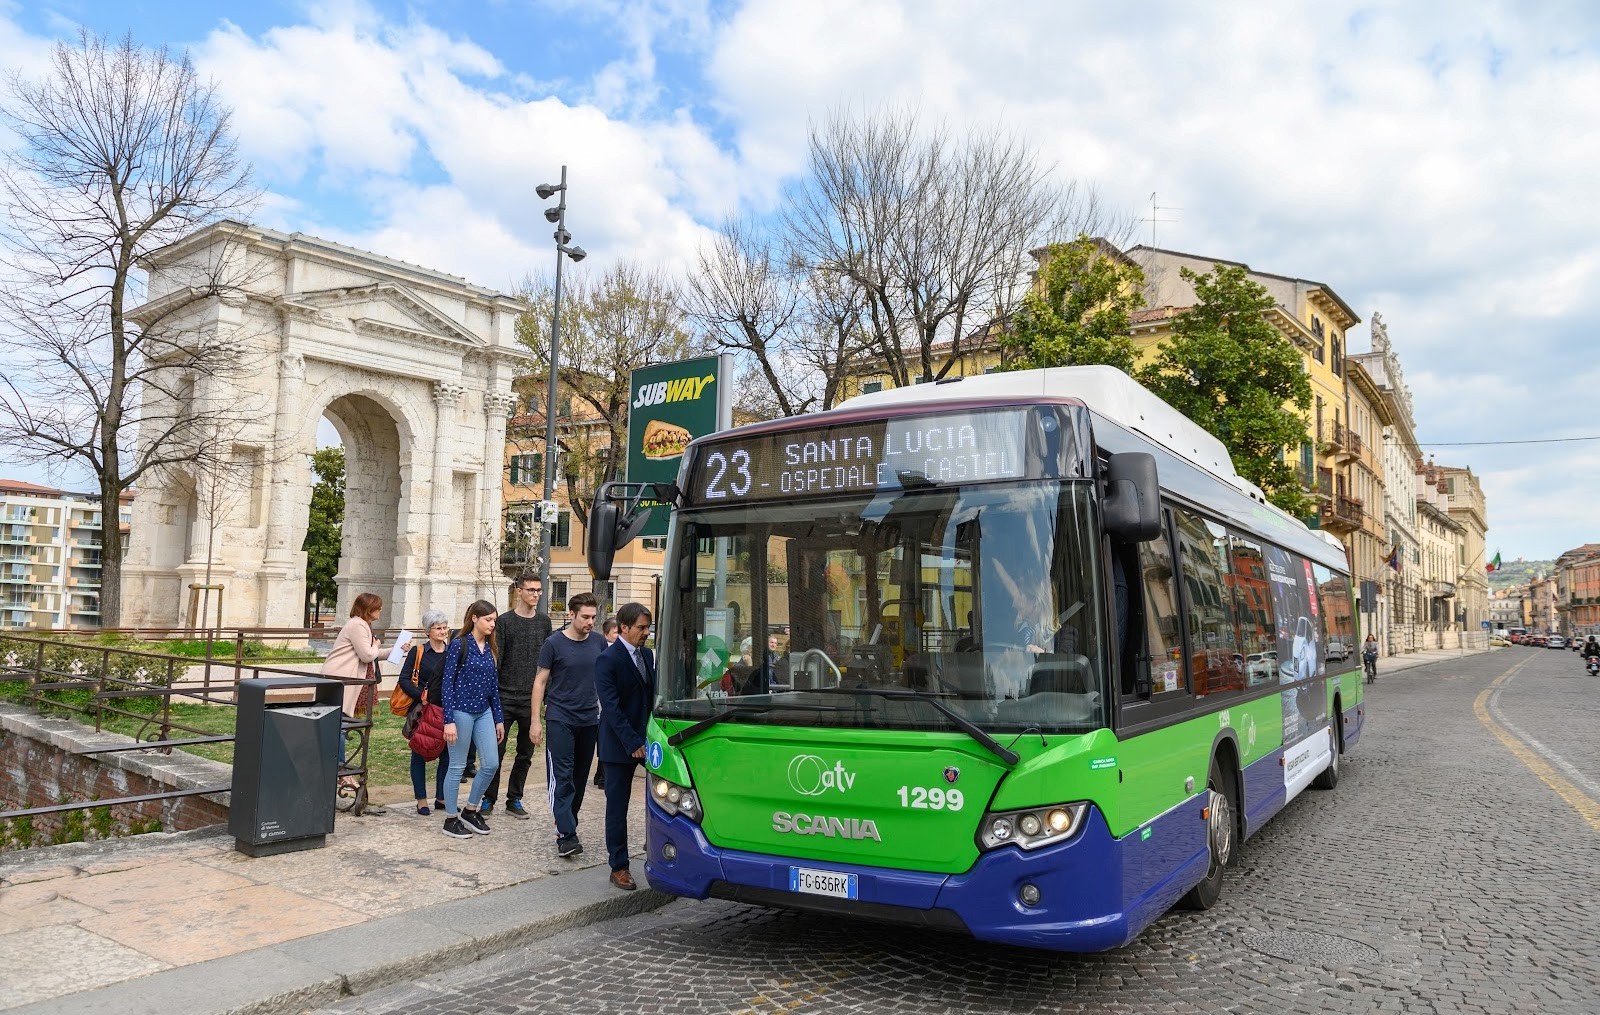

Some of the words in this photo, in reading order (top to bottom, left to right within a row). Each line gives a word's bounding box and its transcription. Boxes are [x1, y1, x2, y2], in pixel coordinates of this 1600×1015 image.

[633, 373, 715, 409] SUBWAY
[785, 436, 872, 465] SANTA
[886, 425, 976, 455] LUCIA
[706, 450, 751, 499] 23
[781, 462, 888, 493] OSPEDALE
[924, 451, 1015, 480] CASTEL
[821, 759, 856, 793] atv
[896, 785, 965, 812] 1299
[772, 811, 882, 842] SCANIA
